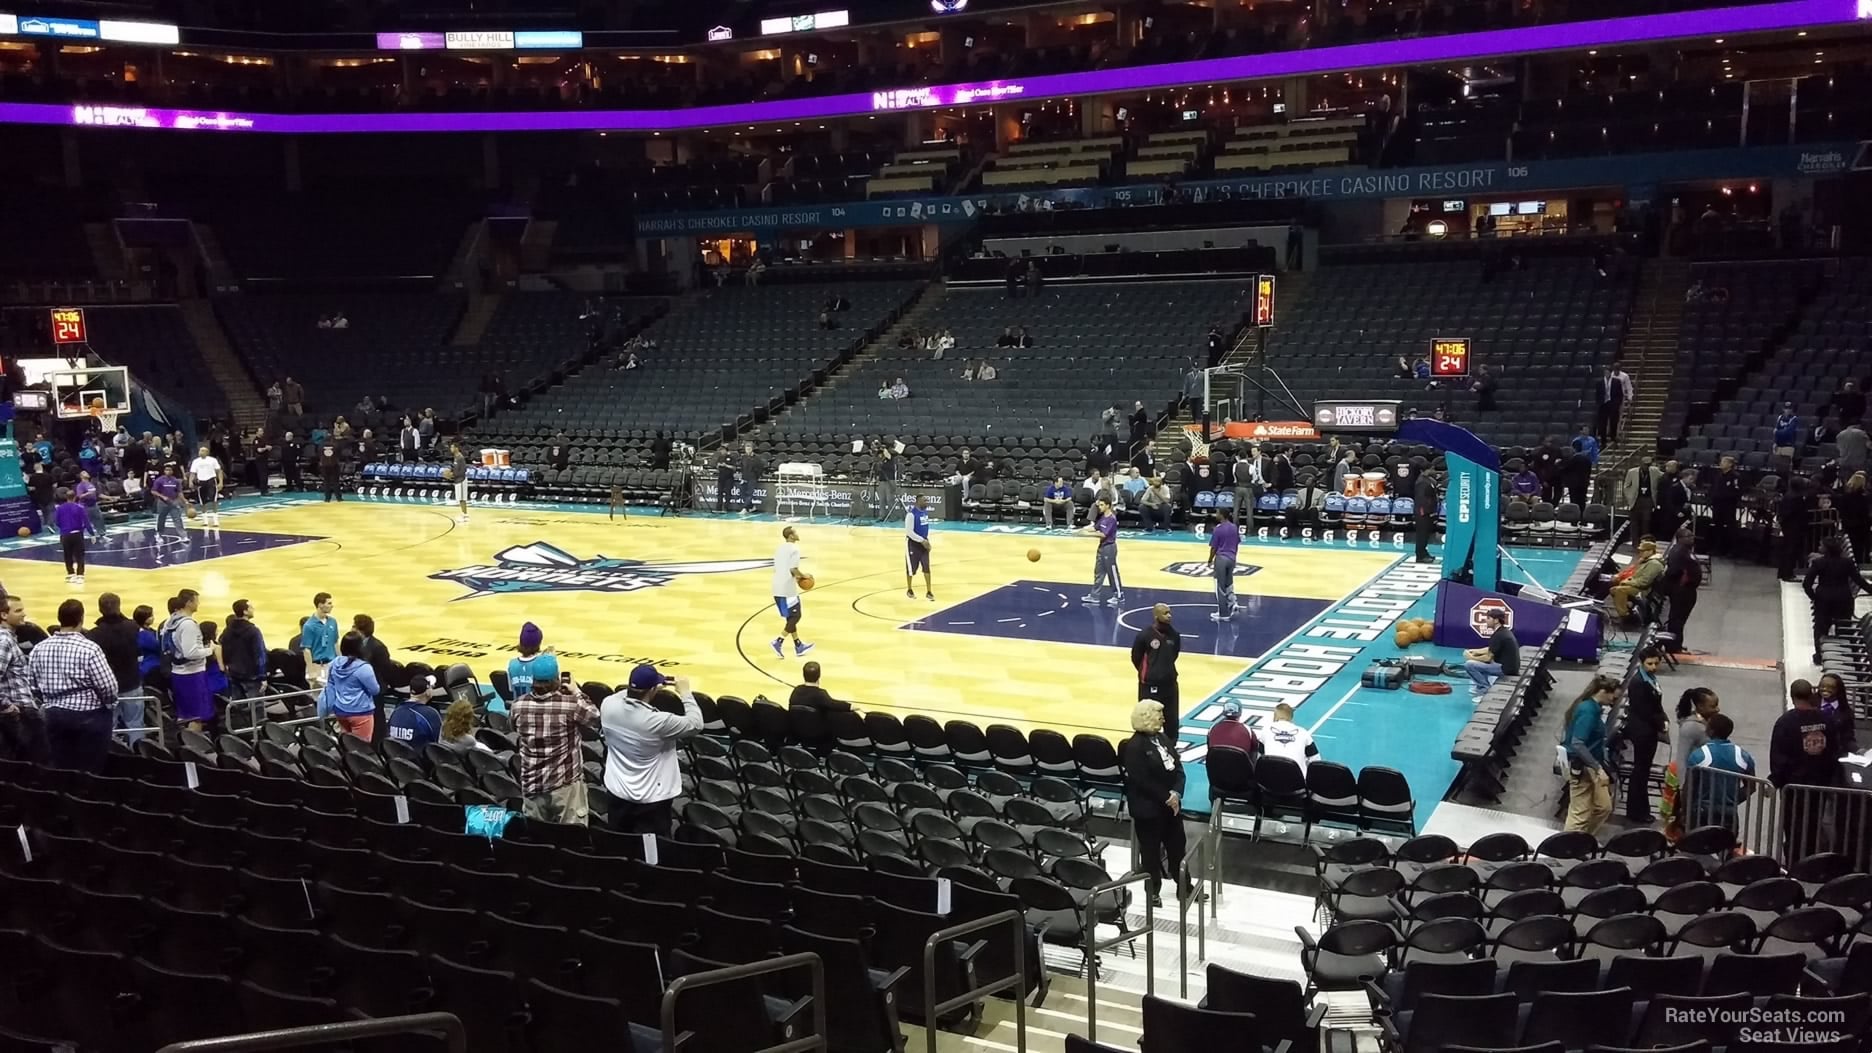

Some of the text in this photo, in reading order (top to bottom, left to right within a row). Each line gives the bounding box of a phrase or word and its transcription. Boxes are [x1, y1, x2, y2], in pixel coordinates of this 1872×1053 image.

[448, 34, 512, 42] BULLY HILL
[1508, 166, 1528, 177] 106
[1341, 172, 1410, 194] CASINO
[1418, 168, 1496, 190] RESORT
[1115, 190, 1131, 200] 105
[832, 208, 846, 217] 104
[688, 216, 738, 230] CHEROKEE
[742, 214, 778, 227] CASINO
[782, 212, 821, 225] RESORT
[58, 322, 80, 338] 24
[1436, 344, 1466, 354] 47:06
[1440, 356, 1460, 370] 24
[1336, 406, 1374, 416] HICKORY
[1336, 416, 1374, 426] TAVERN
[400, 645, 488, 658] Arena
[430, 638, 492, 650] Time
[598, 654, 681, 668] Cable
[1328, 832, 1335, 840] 2
